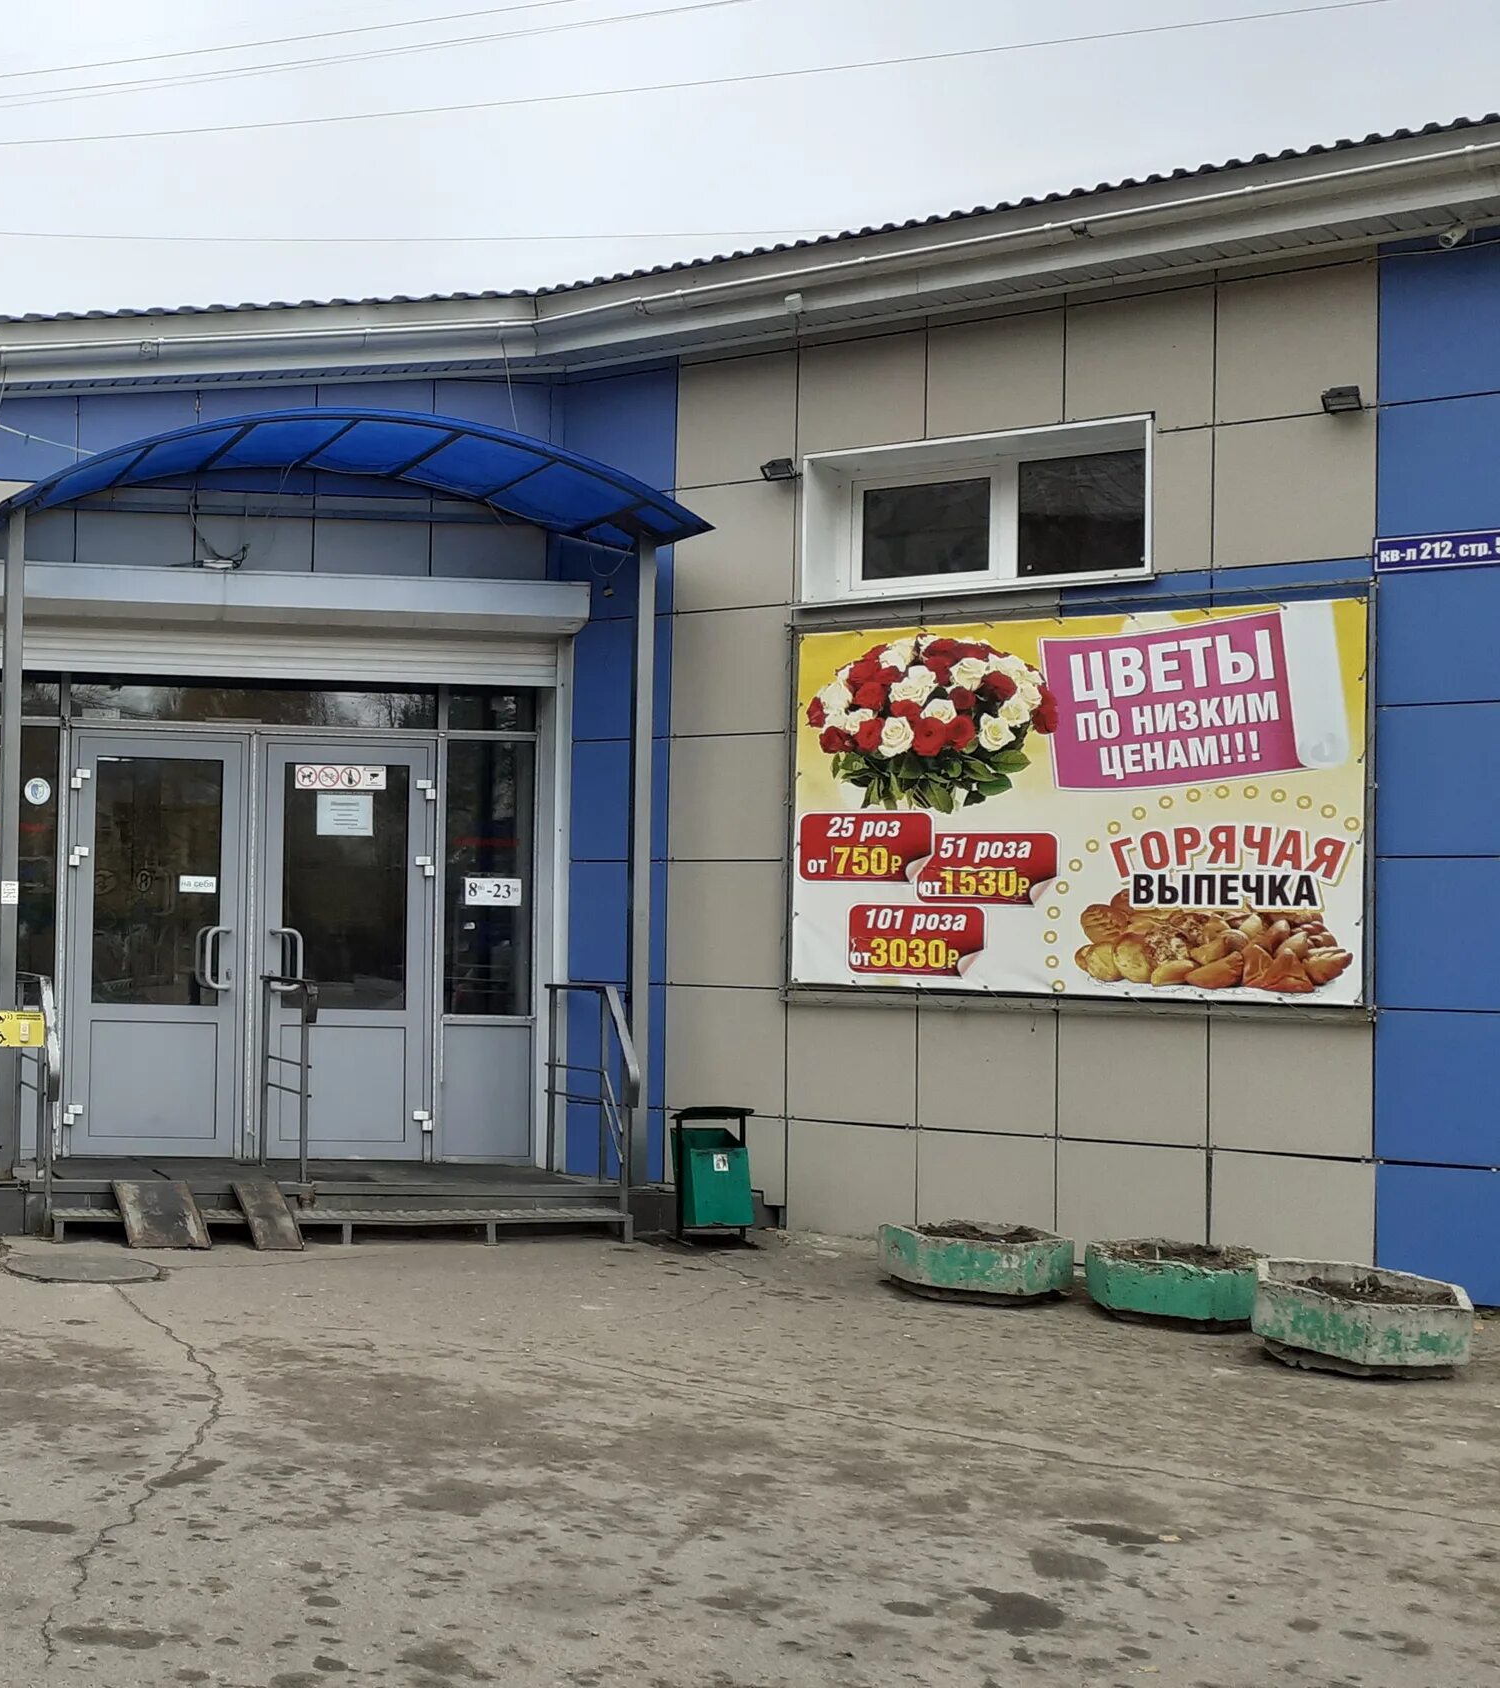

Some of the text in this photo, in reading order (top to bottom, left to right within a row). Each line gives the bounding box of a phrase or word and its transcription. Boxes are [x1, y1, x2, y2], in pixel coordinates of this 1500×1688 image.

[1380, 548, 1417, 562] кв-л
[1420, 541, 1456, 559] 212,
[1459, 543, 1492, 557] стр.
[1069, 629, 1275, 708] ЦВЕТЫ
[1076, 691, 1280, 741] ПО НИЗКИМ
[1100, 731, 1260, 780] ЦЕНАМ!!!
[826, 817, 901, 842] 25 роз
[939, 837, 1032, 863] 51 роза
[1109, 825, 1346, 880] ГОРЯЧАЯ
[807, 859, 828, 874] от
[921, 881, 942, 896] от
[1133, 873, 1318, 906] ВЫПЕЧКА
[866, 908, 967, 934] 101 роза
[851, 951, 871, 966] от
